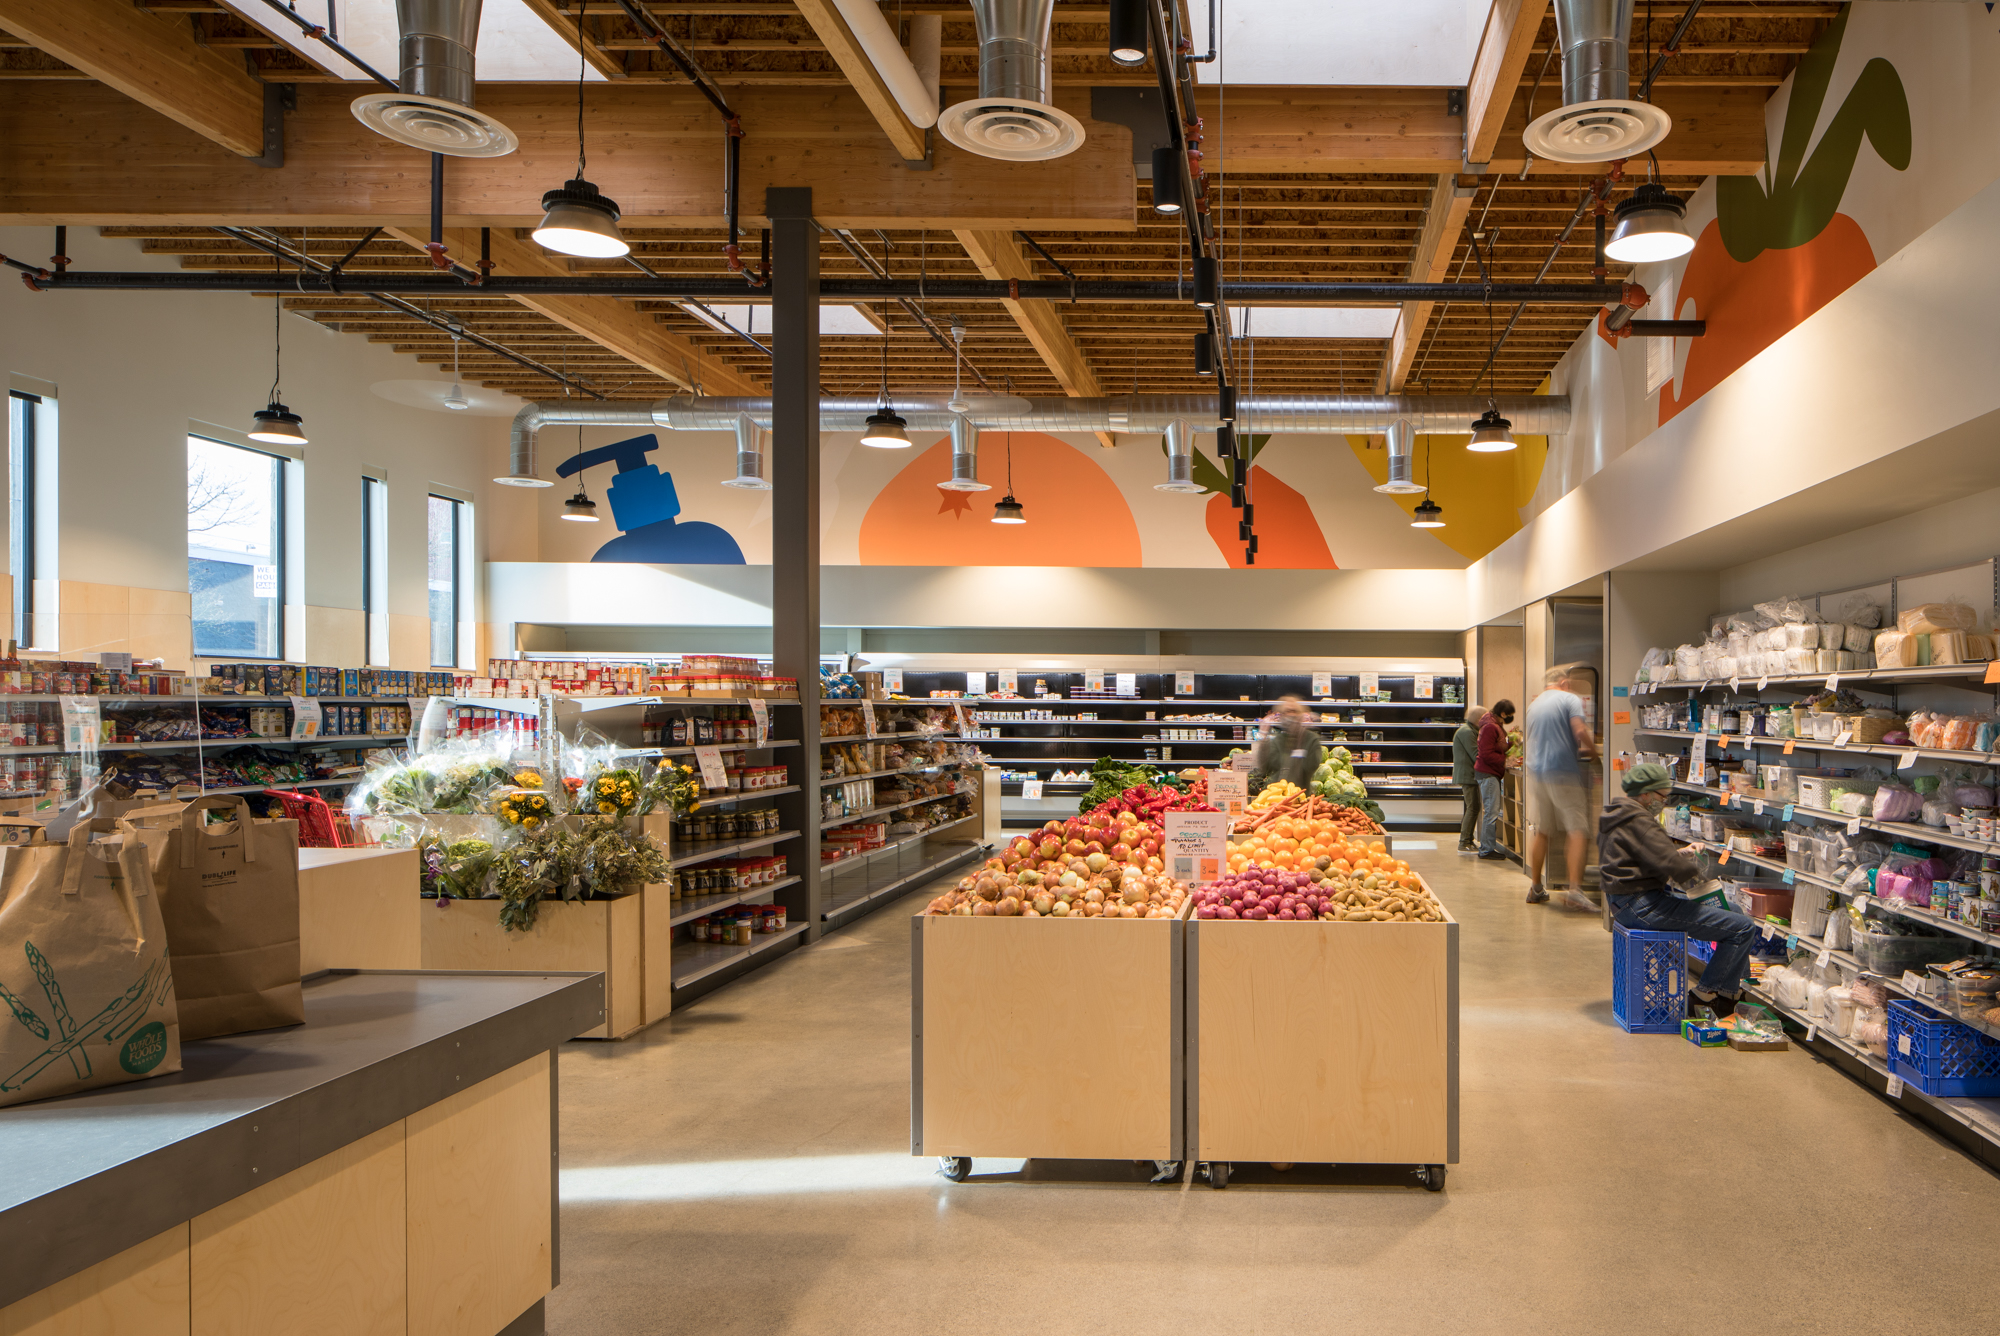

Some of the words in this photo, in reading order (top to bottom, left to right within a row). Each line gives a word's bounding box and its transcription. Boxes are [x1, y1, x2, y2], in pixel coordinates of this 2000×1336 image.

[1202, 866, 1207, 874] 3
[127, 1031, 164, 1053] WHOLE
[1706, 1030, 1722, 1040] Ziploc
[128, 1041, 162, 1063] FOODS
[132, 1053, 157, 1067] MARKET
